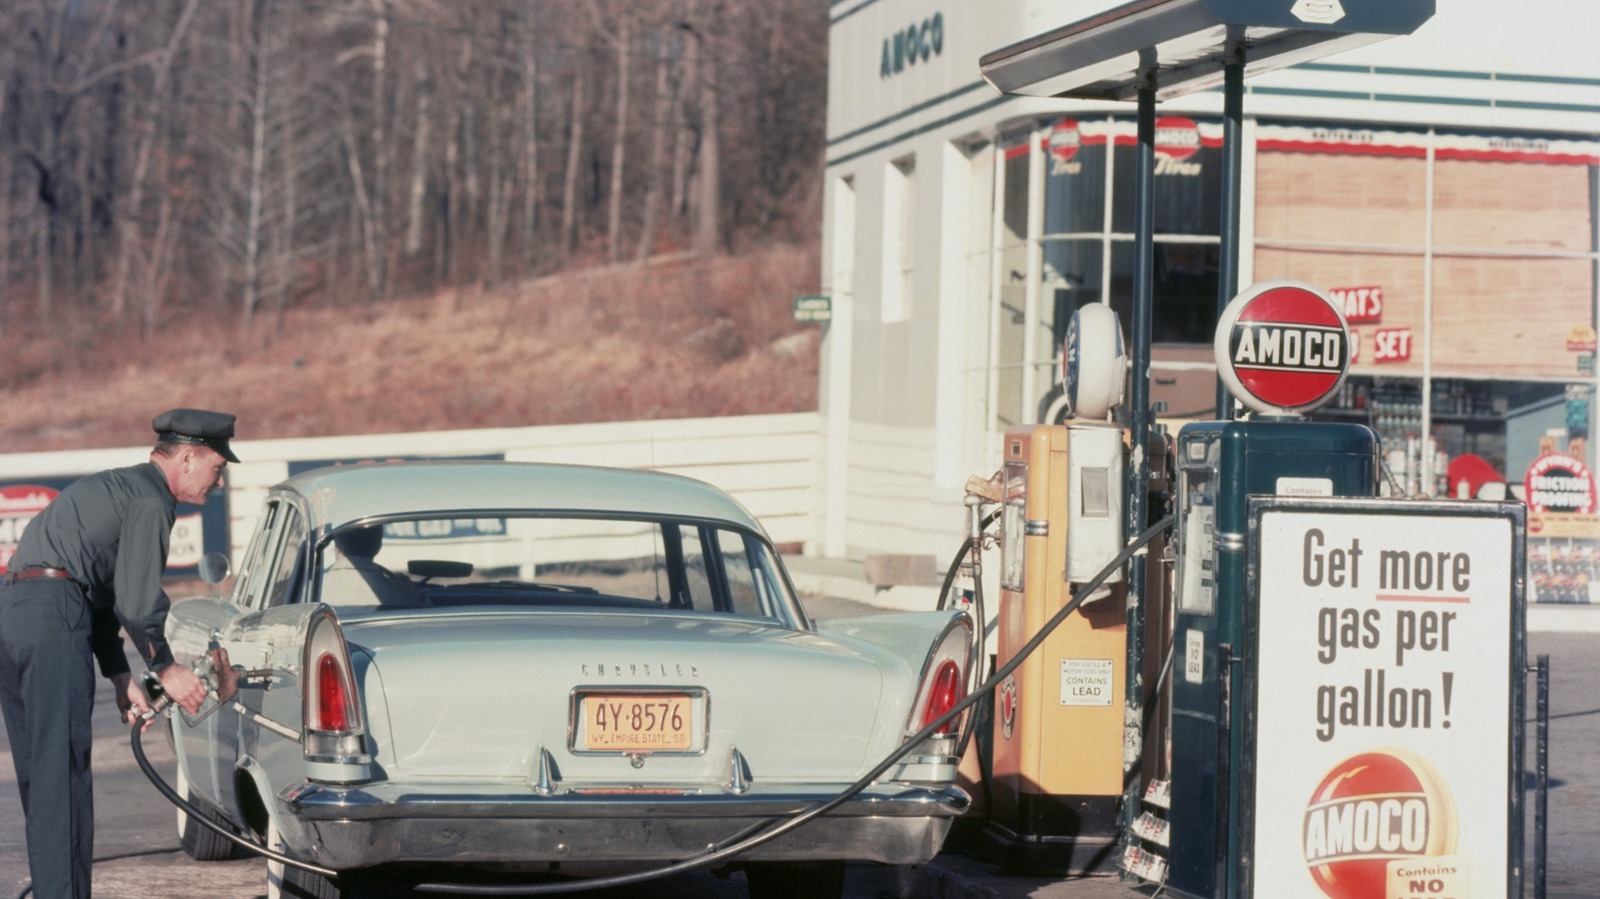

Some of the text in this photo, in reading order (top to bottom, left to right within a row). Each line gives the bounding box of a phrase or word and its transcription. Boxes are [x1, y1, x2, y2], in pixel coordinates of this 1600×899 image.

[880, 11, 943, 79] AMOCO
[1235, 328, 1340, 367] AMOCO
[1375, 330, 1411, 358] SET
[1285, 487, 1323, 495] Contains
[1303, 528, 1471, 592] Get more
[1317, 607, 1457, 666] gas per
[582, 664, 699, 677] CHRYSLER
[1188, 661, 1200, 674] LEAD
[1066, 677, 1108, 685] CONTAINS
[1072, 686, 1101, 696] LEAD
[1316, 668, 1454, 742] gallon!
[611, 734, 640, 743] EMPIRE
[1306, 799, 1426, 860] AMOCO
[1397, 864, 1457, 877] Contains
[1409, 879, 1444, 893] NO
